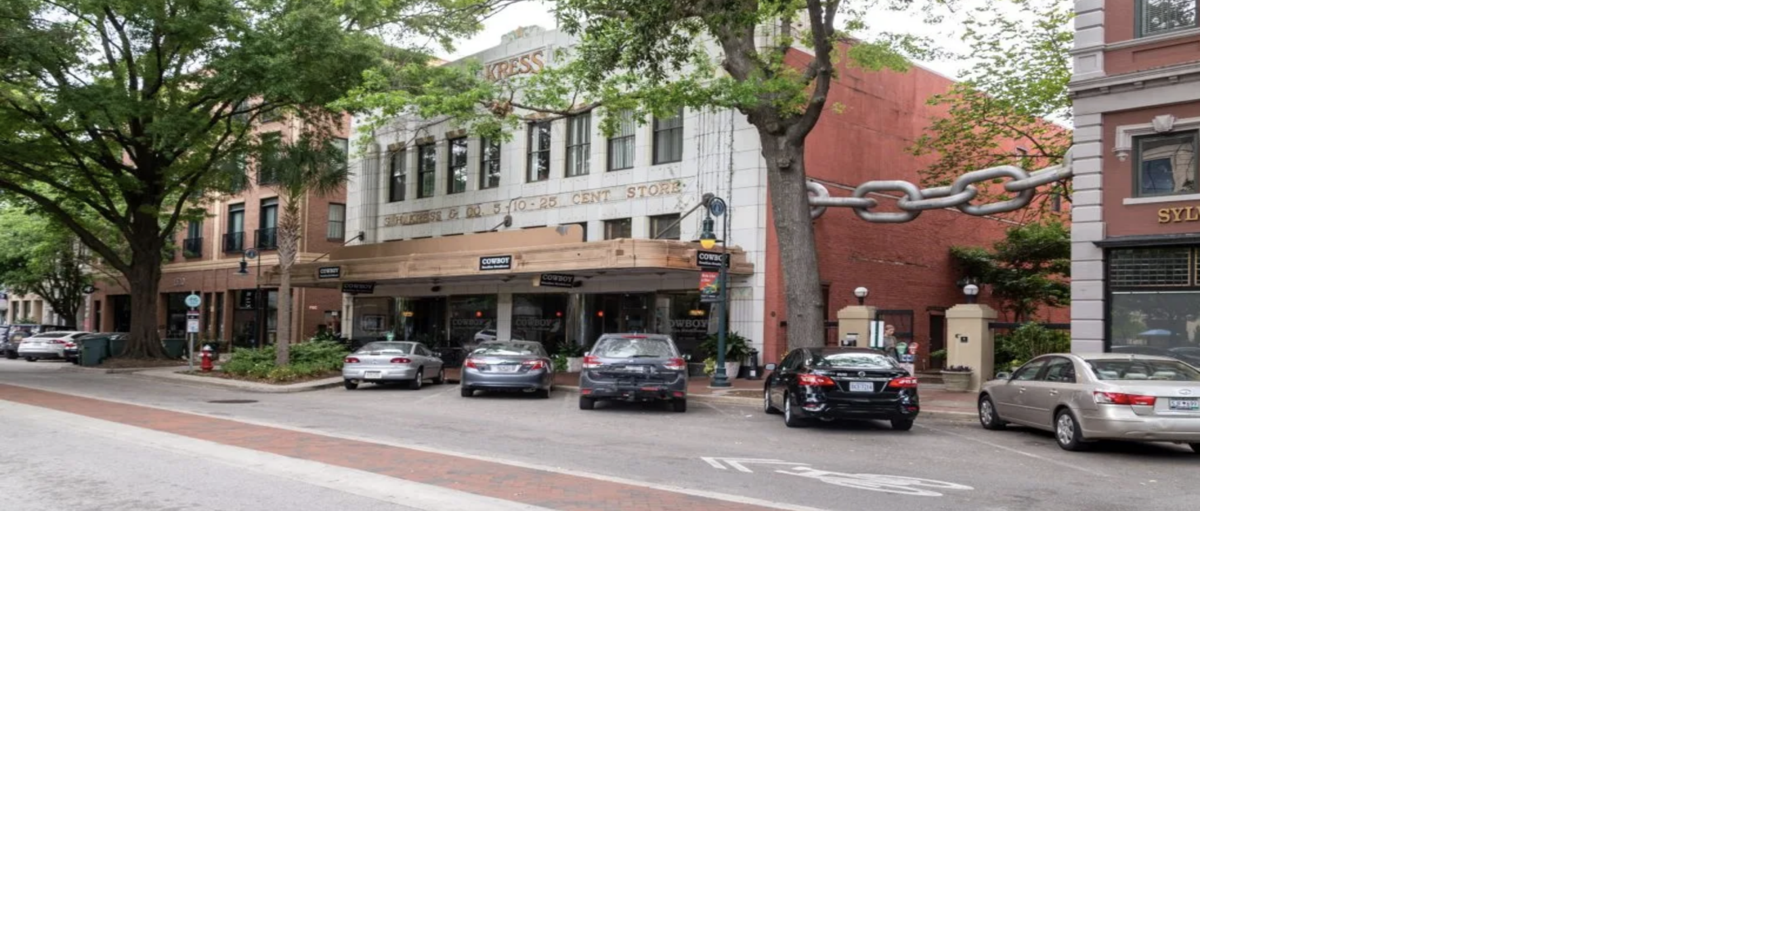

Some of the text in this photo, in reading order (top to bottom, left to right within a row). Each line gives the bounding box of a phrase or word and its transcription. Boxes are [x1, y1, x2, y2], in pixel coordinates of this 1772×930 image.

[485, 50, 544, 81] KRESS
[447, 209, 459, 219] &
[573, 190, 611, 205] CENT
[627, 181, 682, 199] STORE
[482, 257, 510, 265] COWBOY
[542, 274, 573, 283] COWBOY
